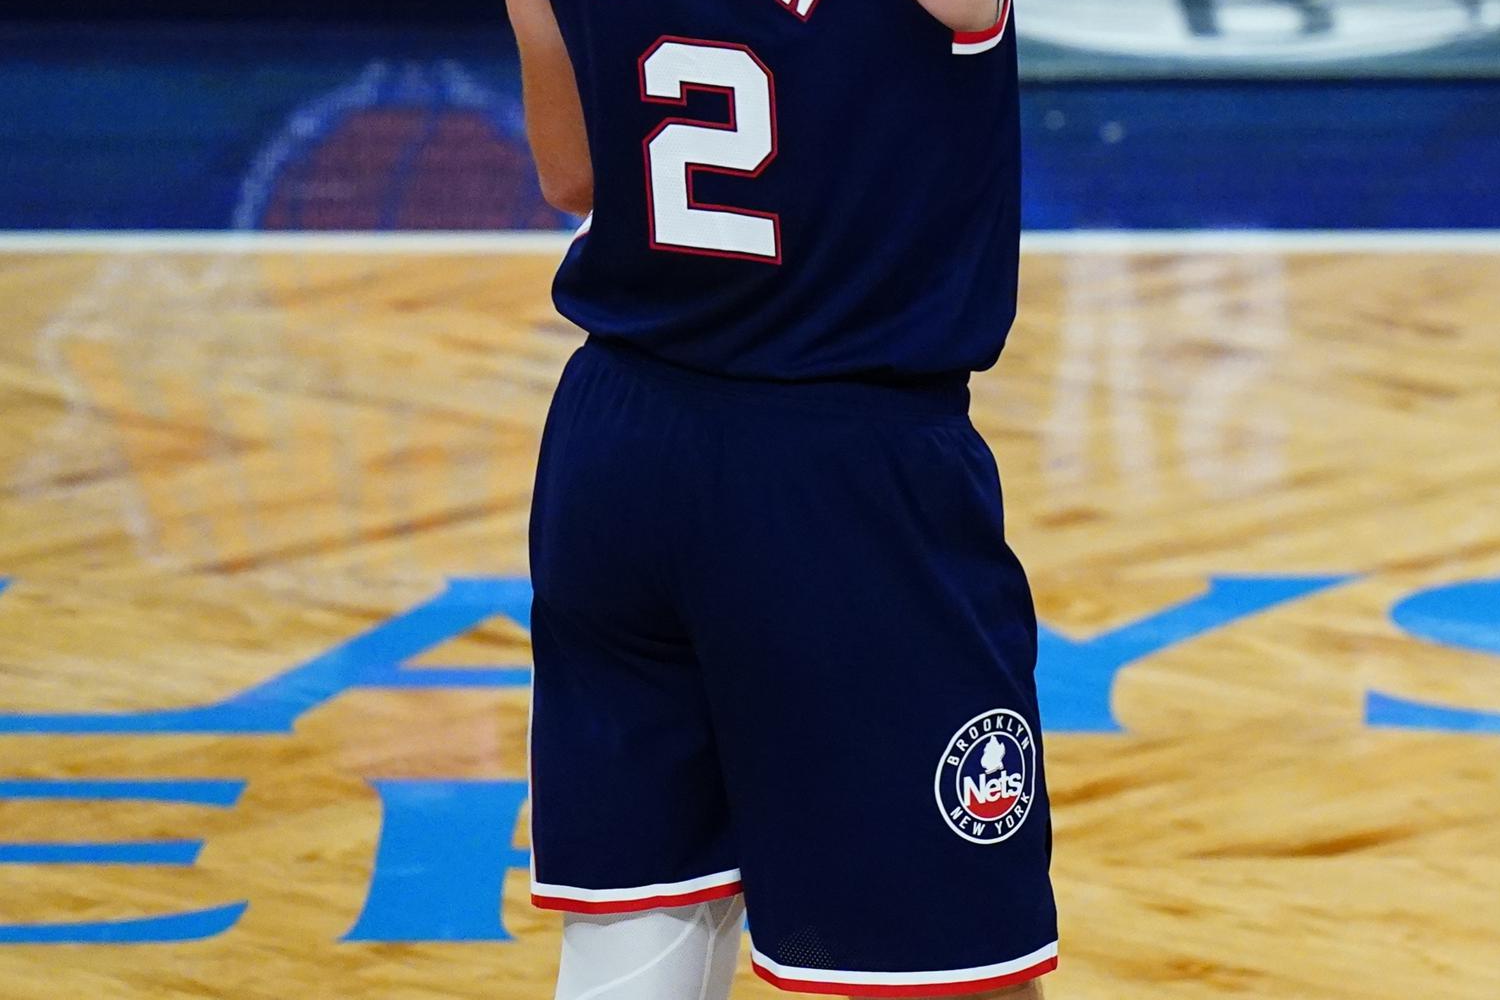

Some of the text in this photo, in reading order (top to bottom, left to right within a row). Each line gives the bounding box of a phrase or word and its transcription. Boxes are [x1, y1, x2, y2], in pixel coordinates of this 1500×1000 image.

[638, 35, 782, 265] 2
[947, 715, 1030, 766] BROOKLYN
[963, 770, 1022, 807] Nets
[950, 792, 1030, 836] NEW YORK
